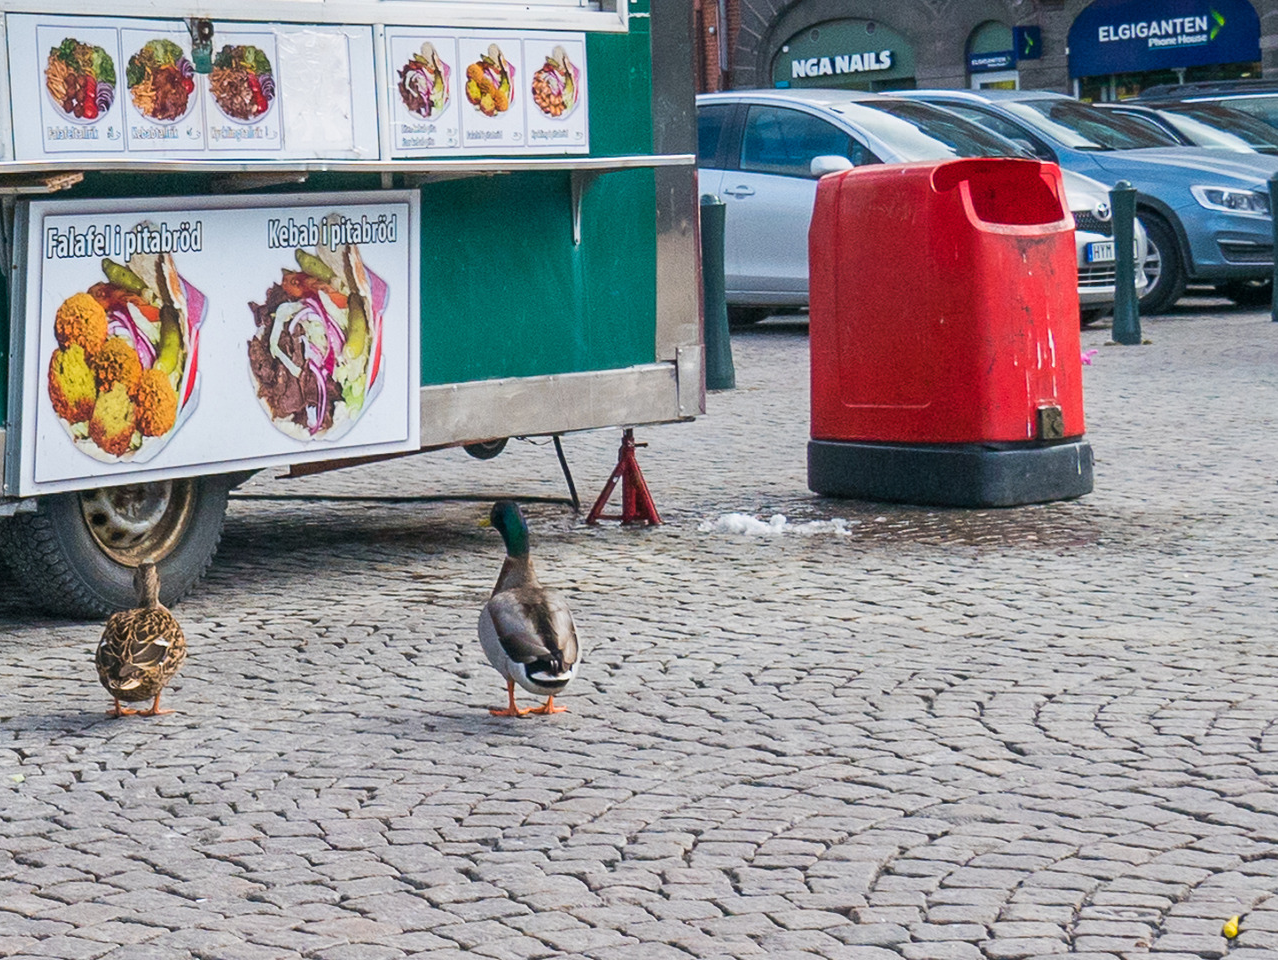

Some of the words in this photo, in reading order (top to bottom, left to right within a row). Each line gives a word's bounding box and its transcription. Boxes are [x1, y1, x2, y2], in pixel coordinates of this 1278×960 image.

[1098, 16, 1208, 42] ELGIGANTEN
[1178, 34, 1207, 45] House
[792, 57, 833, 79] NGA
[835, 50, 892, 75] NAILS
[46, 224, 112, 259] Falafel
[114, 224, 123, 258] i
[124, 221, 202, 263] pitabröd
[268, 218, 319, 249] Kebab
[321, 217, 329, 248] i
[330, 214, 397, 251] pitabröd
